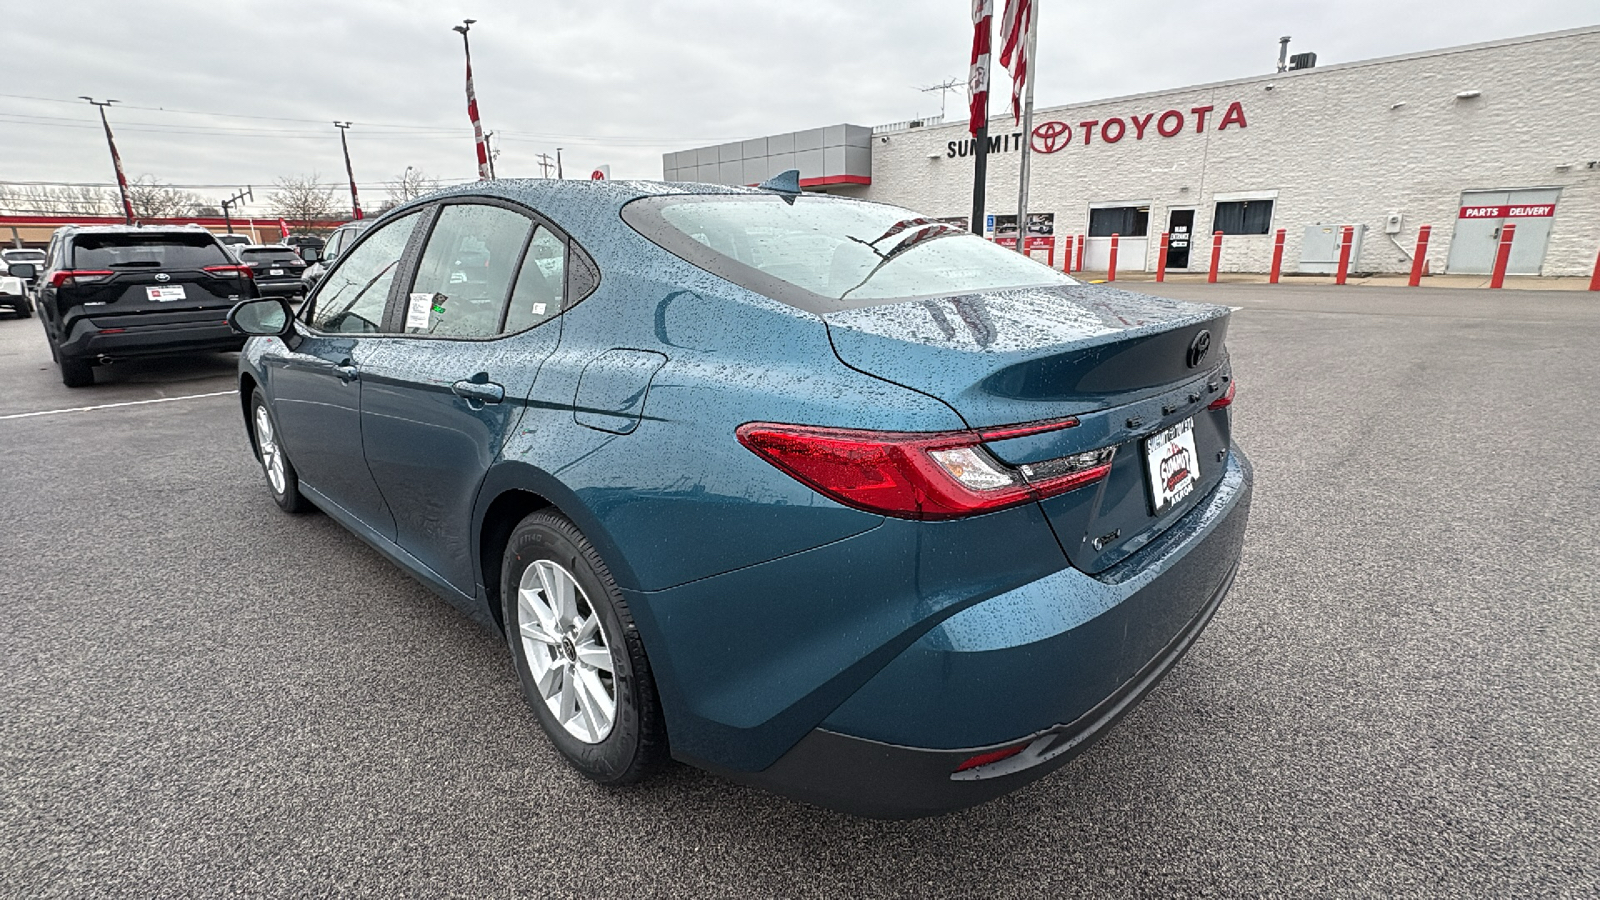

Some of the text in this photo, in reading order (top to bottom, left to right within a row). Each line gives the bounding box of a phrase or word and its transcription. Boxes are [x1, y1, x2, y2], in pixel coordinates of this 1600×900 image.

[1079, 101, 1247, 145] TOYOTA
[1465, 206, 1551, 217] PARTS DELIVERY
